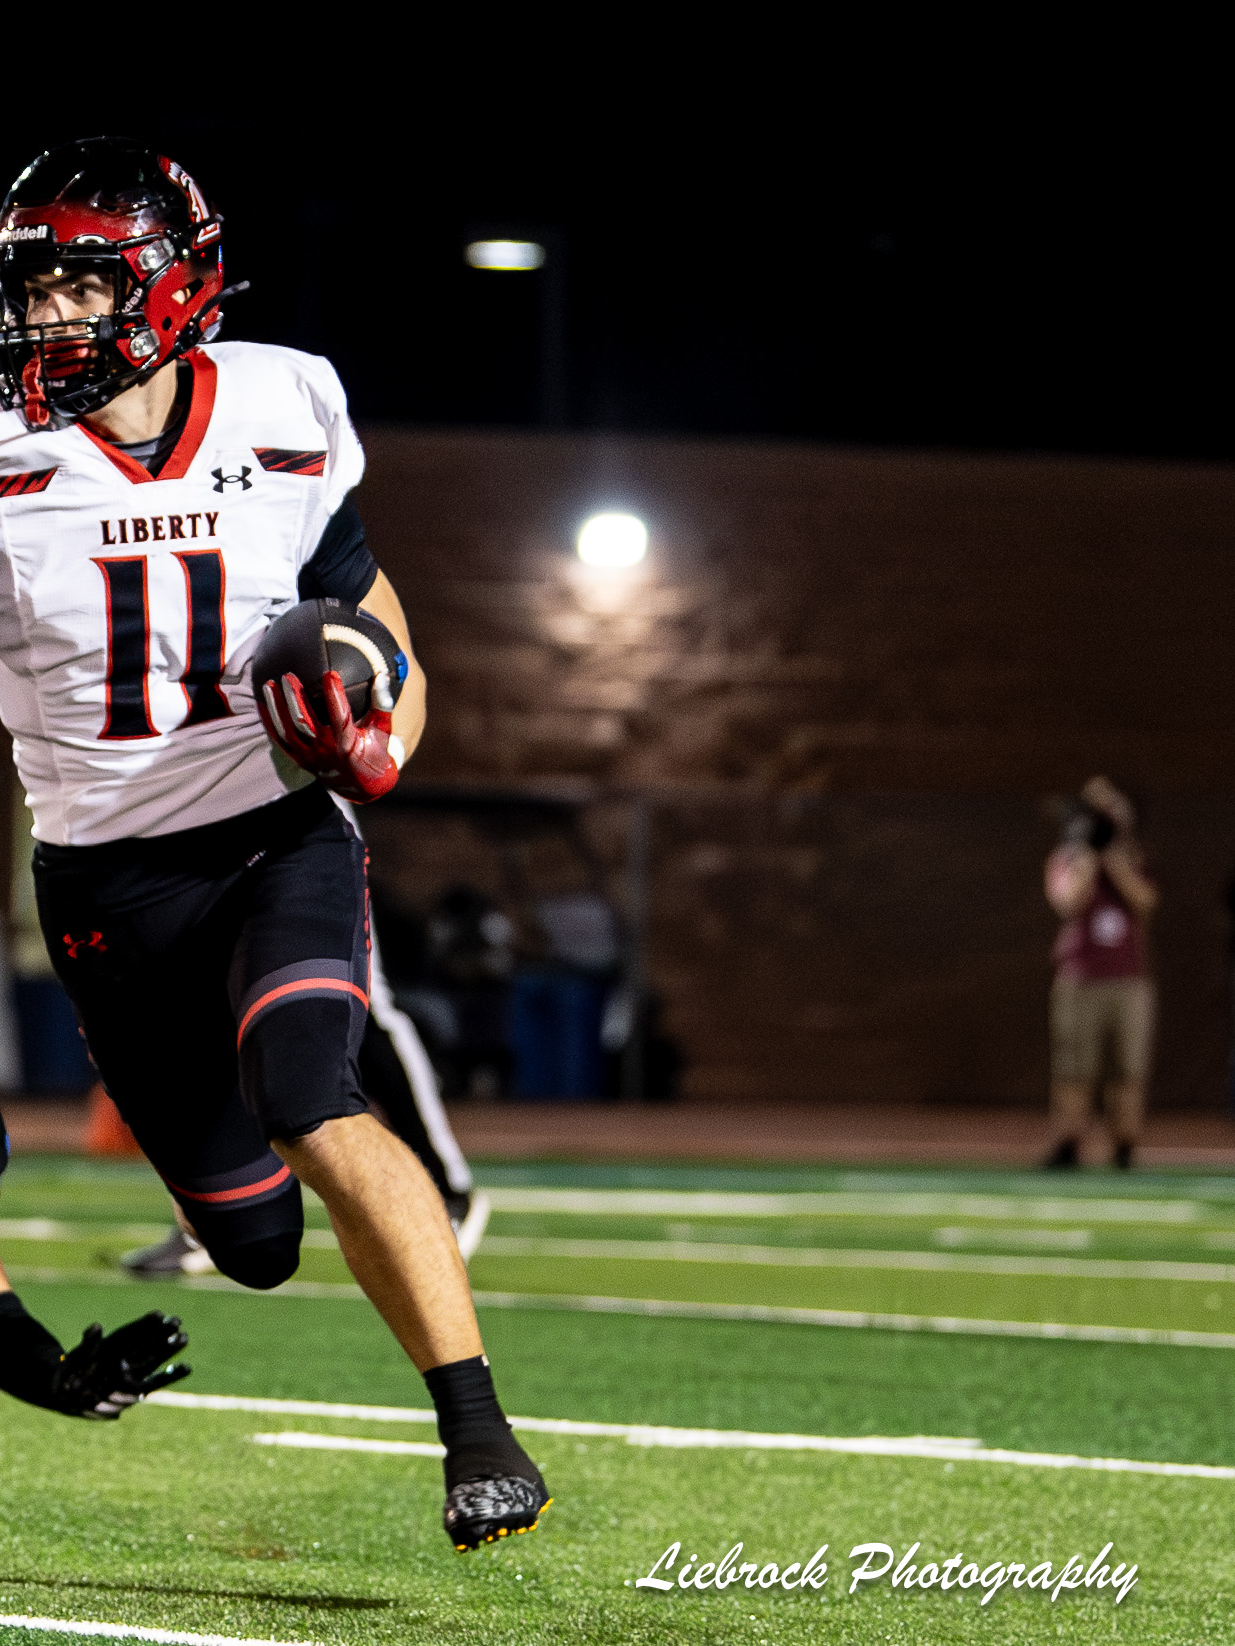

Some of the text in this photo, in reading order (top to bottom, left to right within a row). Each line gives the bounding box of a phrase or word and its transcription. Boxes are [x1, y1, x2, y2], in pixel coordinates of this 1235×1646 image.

[1, 225, 48, 242] ddell
[100, 511, 219, 545] LIBERTY
[89, 548, 235, 741] 11
